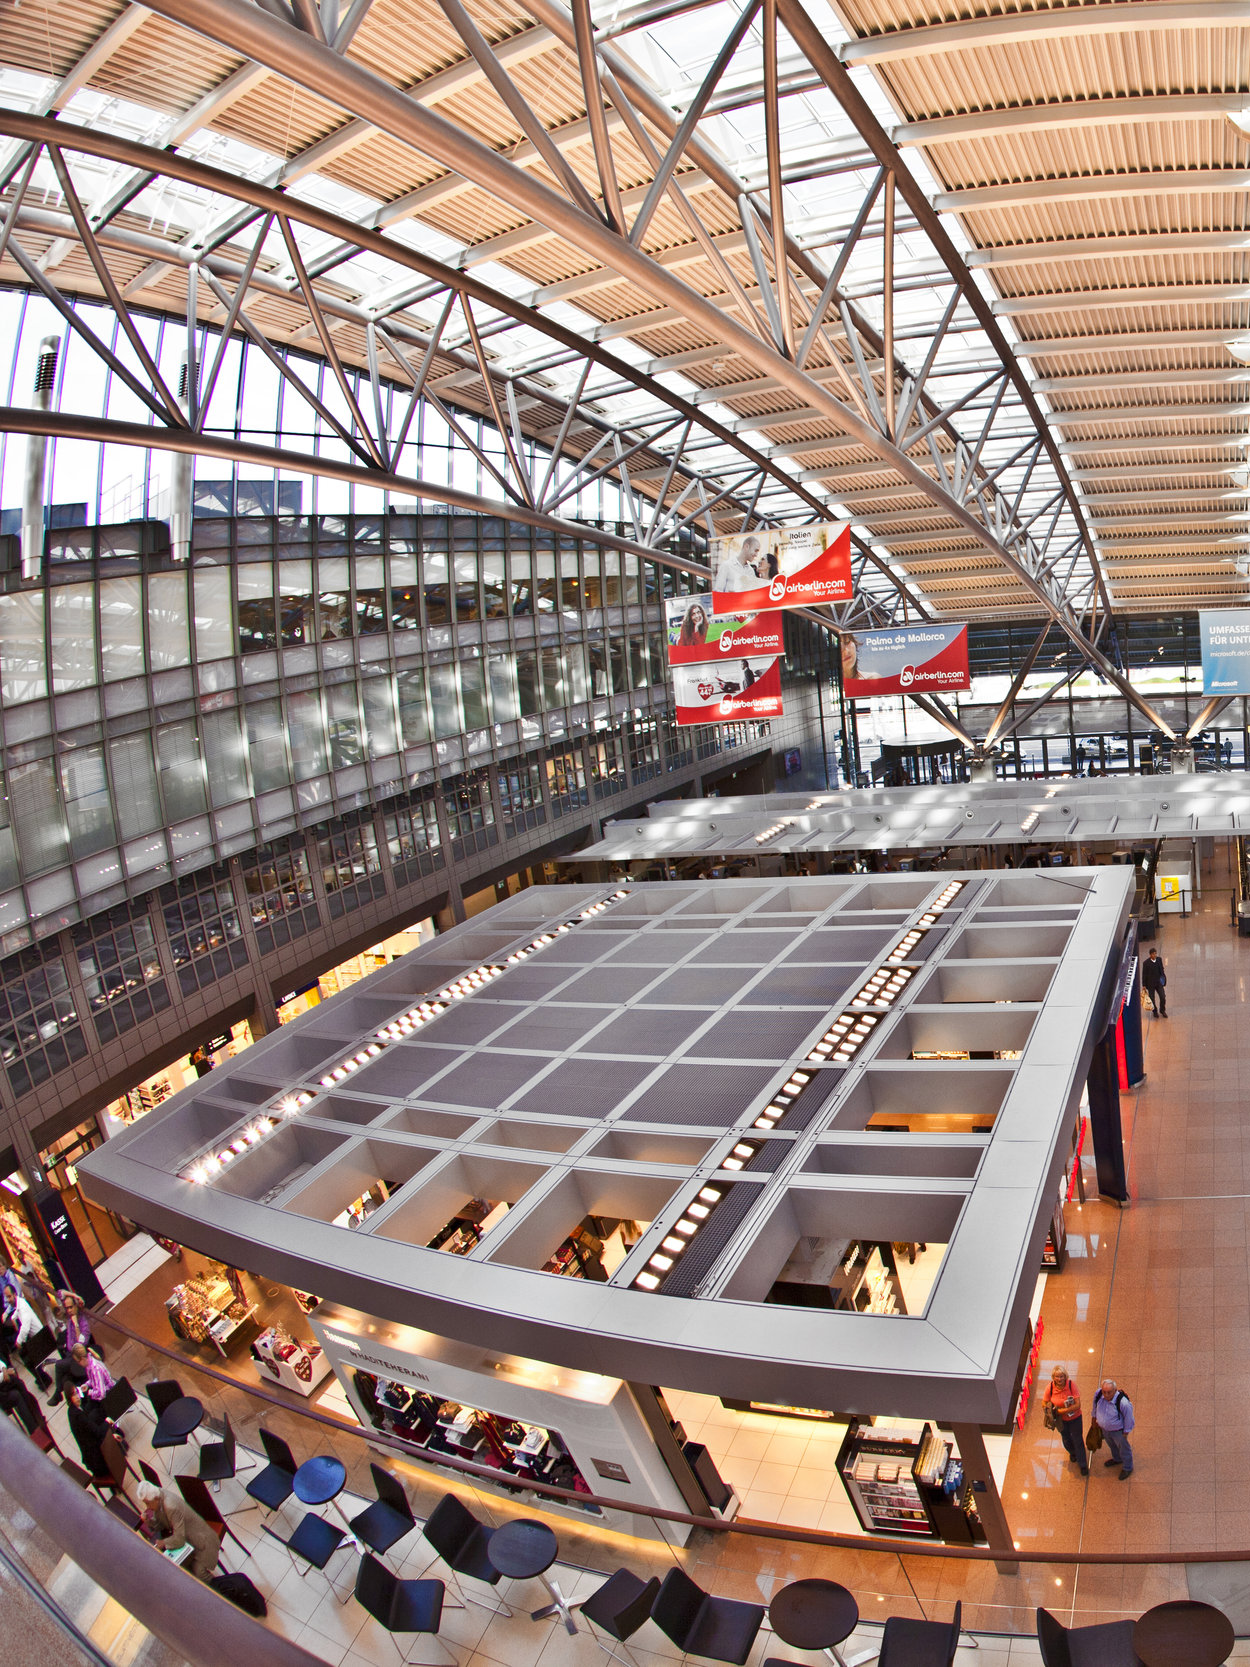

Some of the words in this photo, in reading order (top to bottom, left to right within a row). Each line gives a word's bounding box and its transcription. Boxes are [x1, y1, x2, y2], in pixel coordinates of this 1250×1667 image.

[789, 531, 812, 540] Italien
[786, 579, 846, 593] airberlin.com
[732, 634, 779, 646] airberlin.com
[866, 636, 893, 646] Palma
[894, 635, 906, 643] de
[908, 633, 945, 642] Mallorca
[1209, 635, 1228, 645] FÜR
[914, 670, 964, 681] airberlin.com
